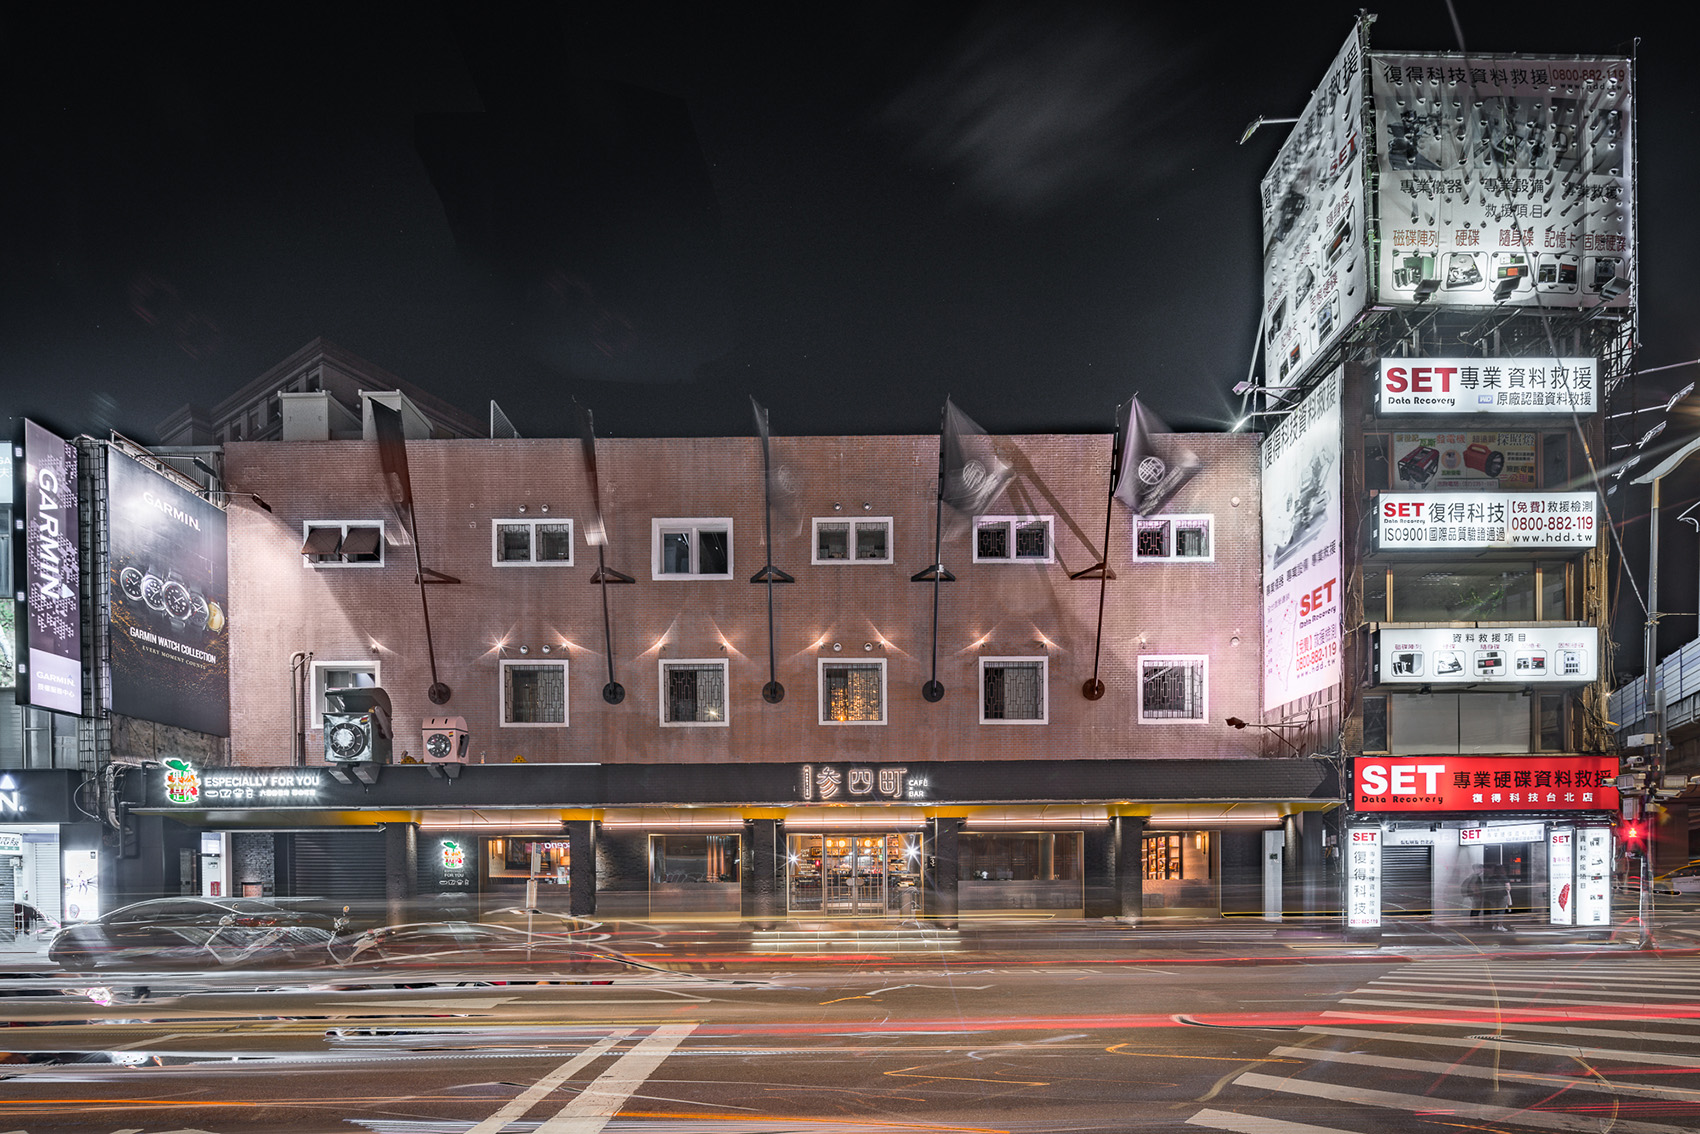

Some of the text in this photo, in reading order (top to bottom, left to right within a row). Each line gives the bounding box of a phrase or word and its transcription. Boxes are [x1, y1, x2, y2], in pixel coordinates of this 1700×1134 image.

[1384, 65, 1549, 85] 復得科技資料救援
[1329, 132, 1357, 177] SET
[1455, 229, 1480, 247] 硬碟
[1386, 367, 1457, 393] SET
[1388, 396, 1456, 407] Data Recovery
[1496, 392, 1592, 406] 原廠認證資料救援
[142, 491, 200, 531] GARMIN
[1384, 503, 1424, 517] SET
[1429, 502, 1505, 524] 復得科技
[1511, 516, 1593, 531] 0800-882-119
[38, 468, 60, 601] GARMIN
[1512, 533, 1593, 542] www.hdd.tw
[1300, 577, 1336, 617] SET
[129, 626, 217, 664] GARMIN WATCH COLLECTION
[1453, 633, 1526, 643] 資料救援項目
[142, 645, 160, 655] EVERY
[161, 652, 184, 663] MOMENT
[1296, 641, 1336, 671] 0800-882-119
[36, 671, 75, 687] GARMIN
[205, 776, 320, 787] ESPECIALLY FOR YOU
[1361, 764, 1445, 795] SET
[1453, 770, 1612, 789] 專業硬碟資料救援
[1393, 796, 1444, 804] Recovery
[1353, 832, 1376, 841] SET
[1462, 829, 1481, 840] SET
[1552, 835, 1570, 843] SET
[1354, 851, 1366, 914] 復得科技
